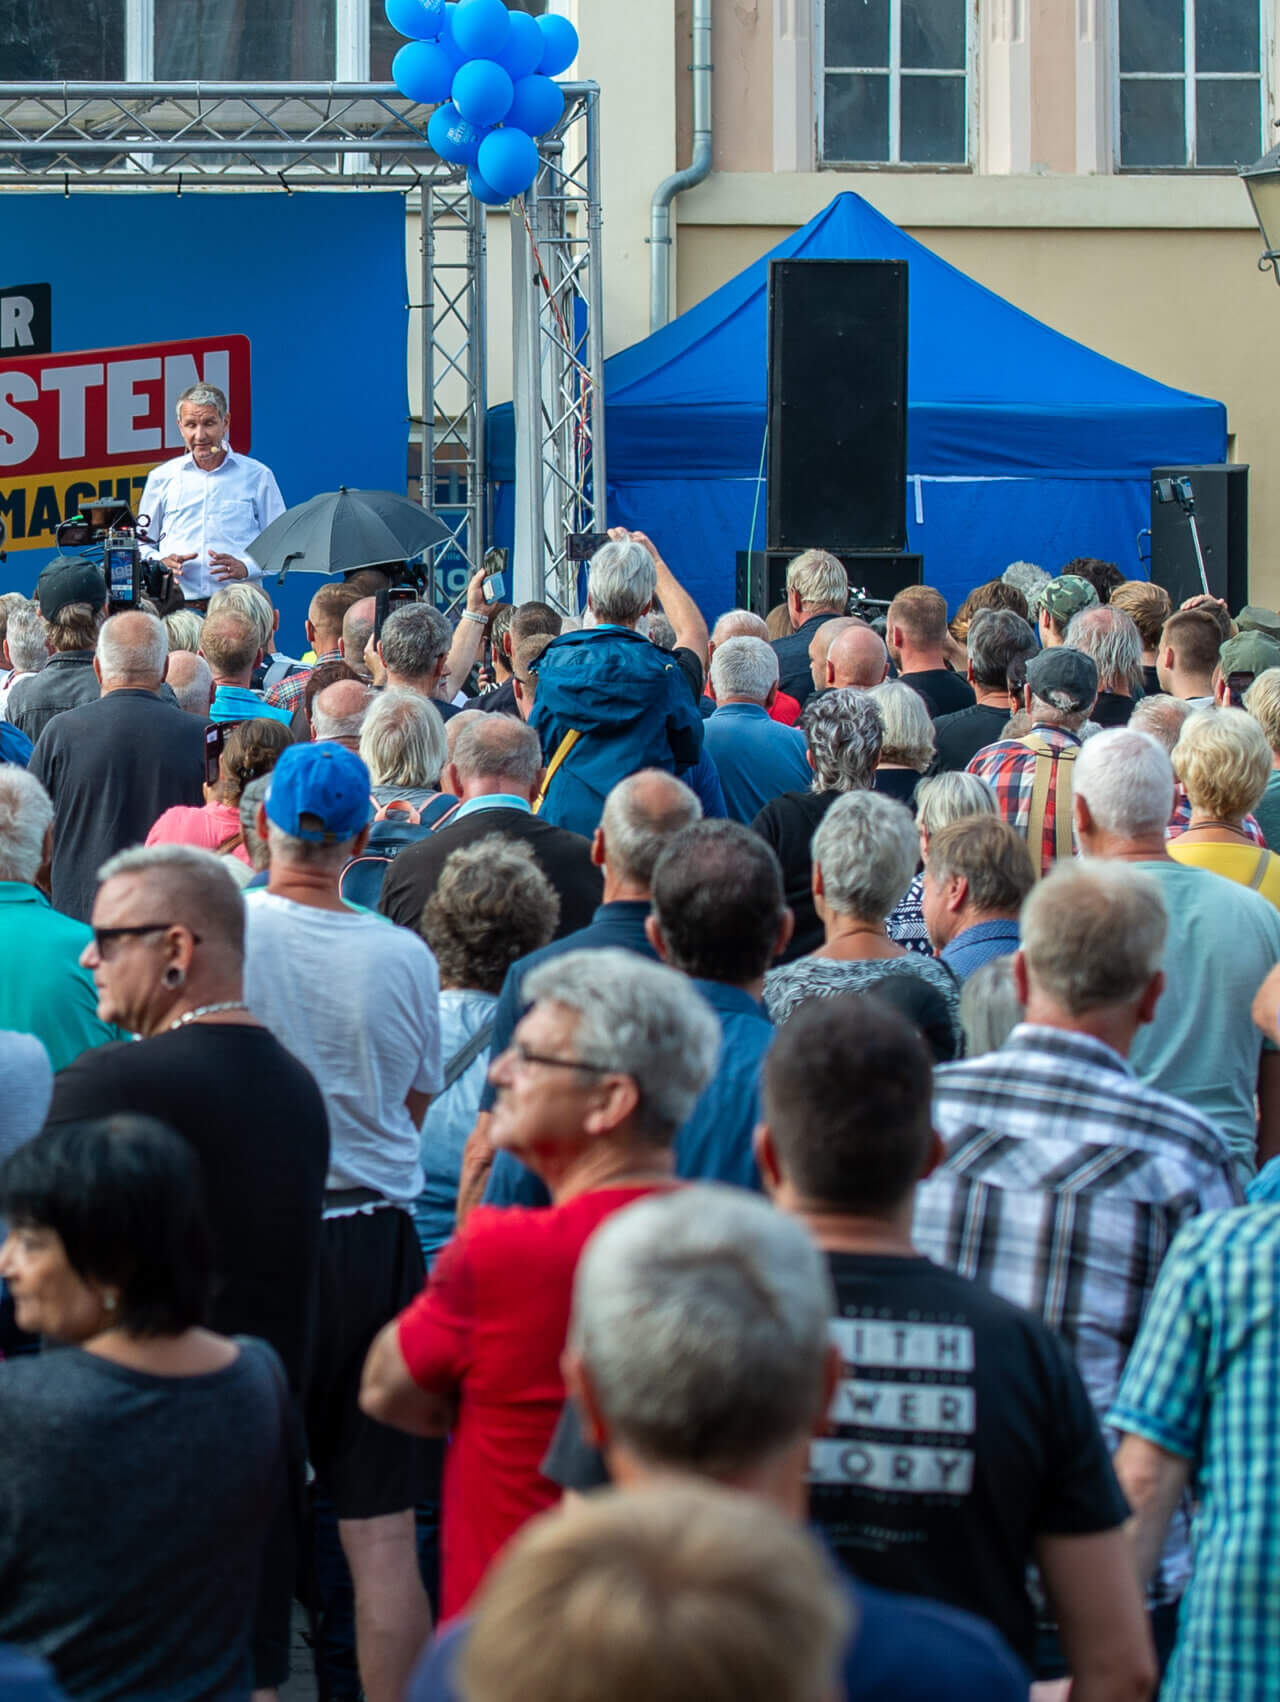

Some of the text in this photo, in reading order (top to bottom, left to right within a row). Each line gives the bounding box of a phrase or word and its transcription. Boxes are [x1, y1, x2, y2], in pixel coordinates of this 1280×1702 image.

[854, 1328, 960, 1362] ITH
[846, 1389, 961, 1426] WER
[839, 1445, 960, 1484] ORY
